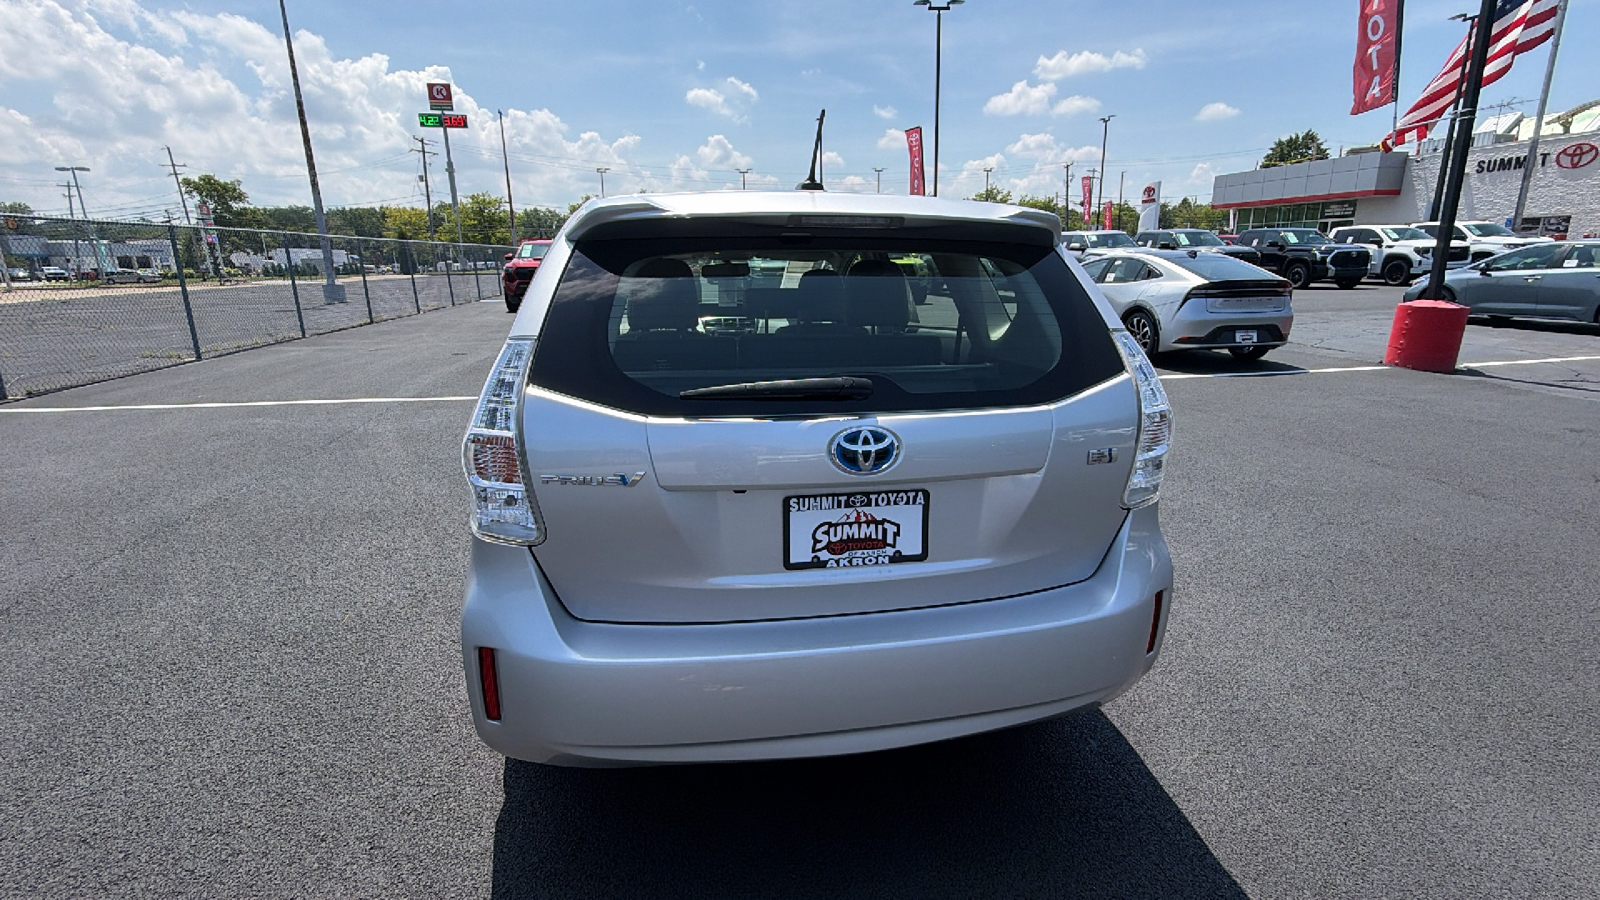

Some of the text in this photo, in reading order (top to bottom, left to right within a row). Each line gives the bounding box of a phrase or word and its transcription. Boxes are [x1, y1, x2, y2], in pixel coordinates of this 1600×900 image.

[435, 87, 447, 98] K
[1475, 152, 1551, 174] SUMMT
[539, 474, 621, 486] PRIUS
[789, 491, 925, 512] SUMMIT TOYOTA
[813, 521, 898, 550] SUMMIT
[847, 541, 885, 550] TOYOTA
[826, 556, 890, 568] AKRON
